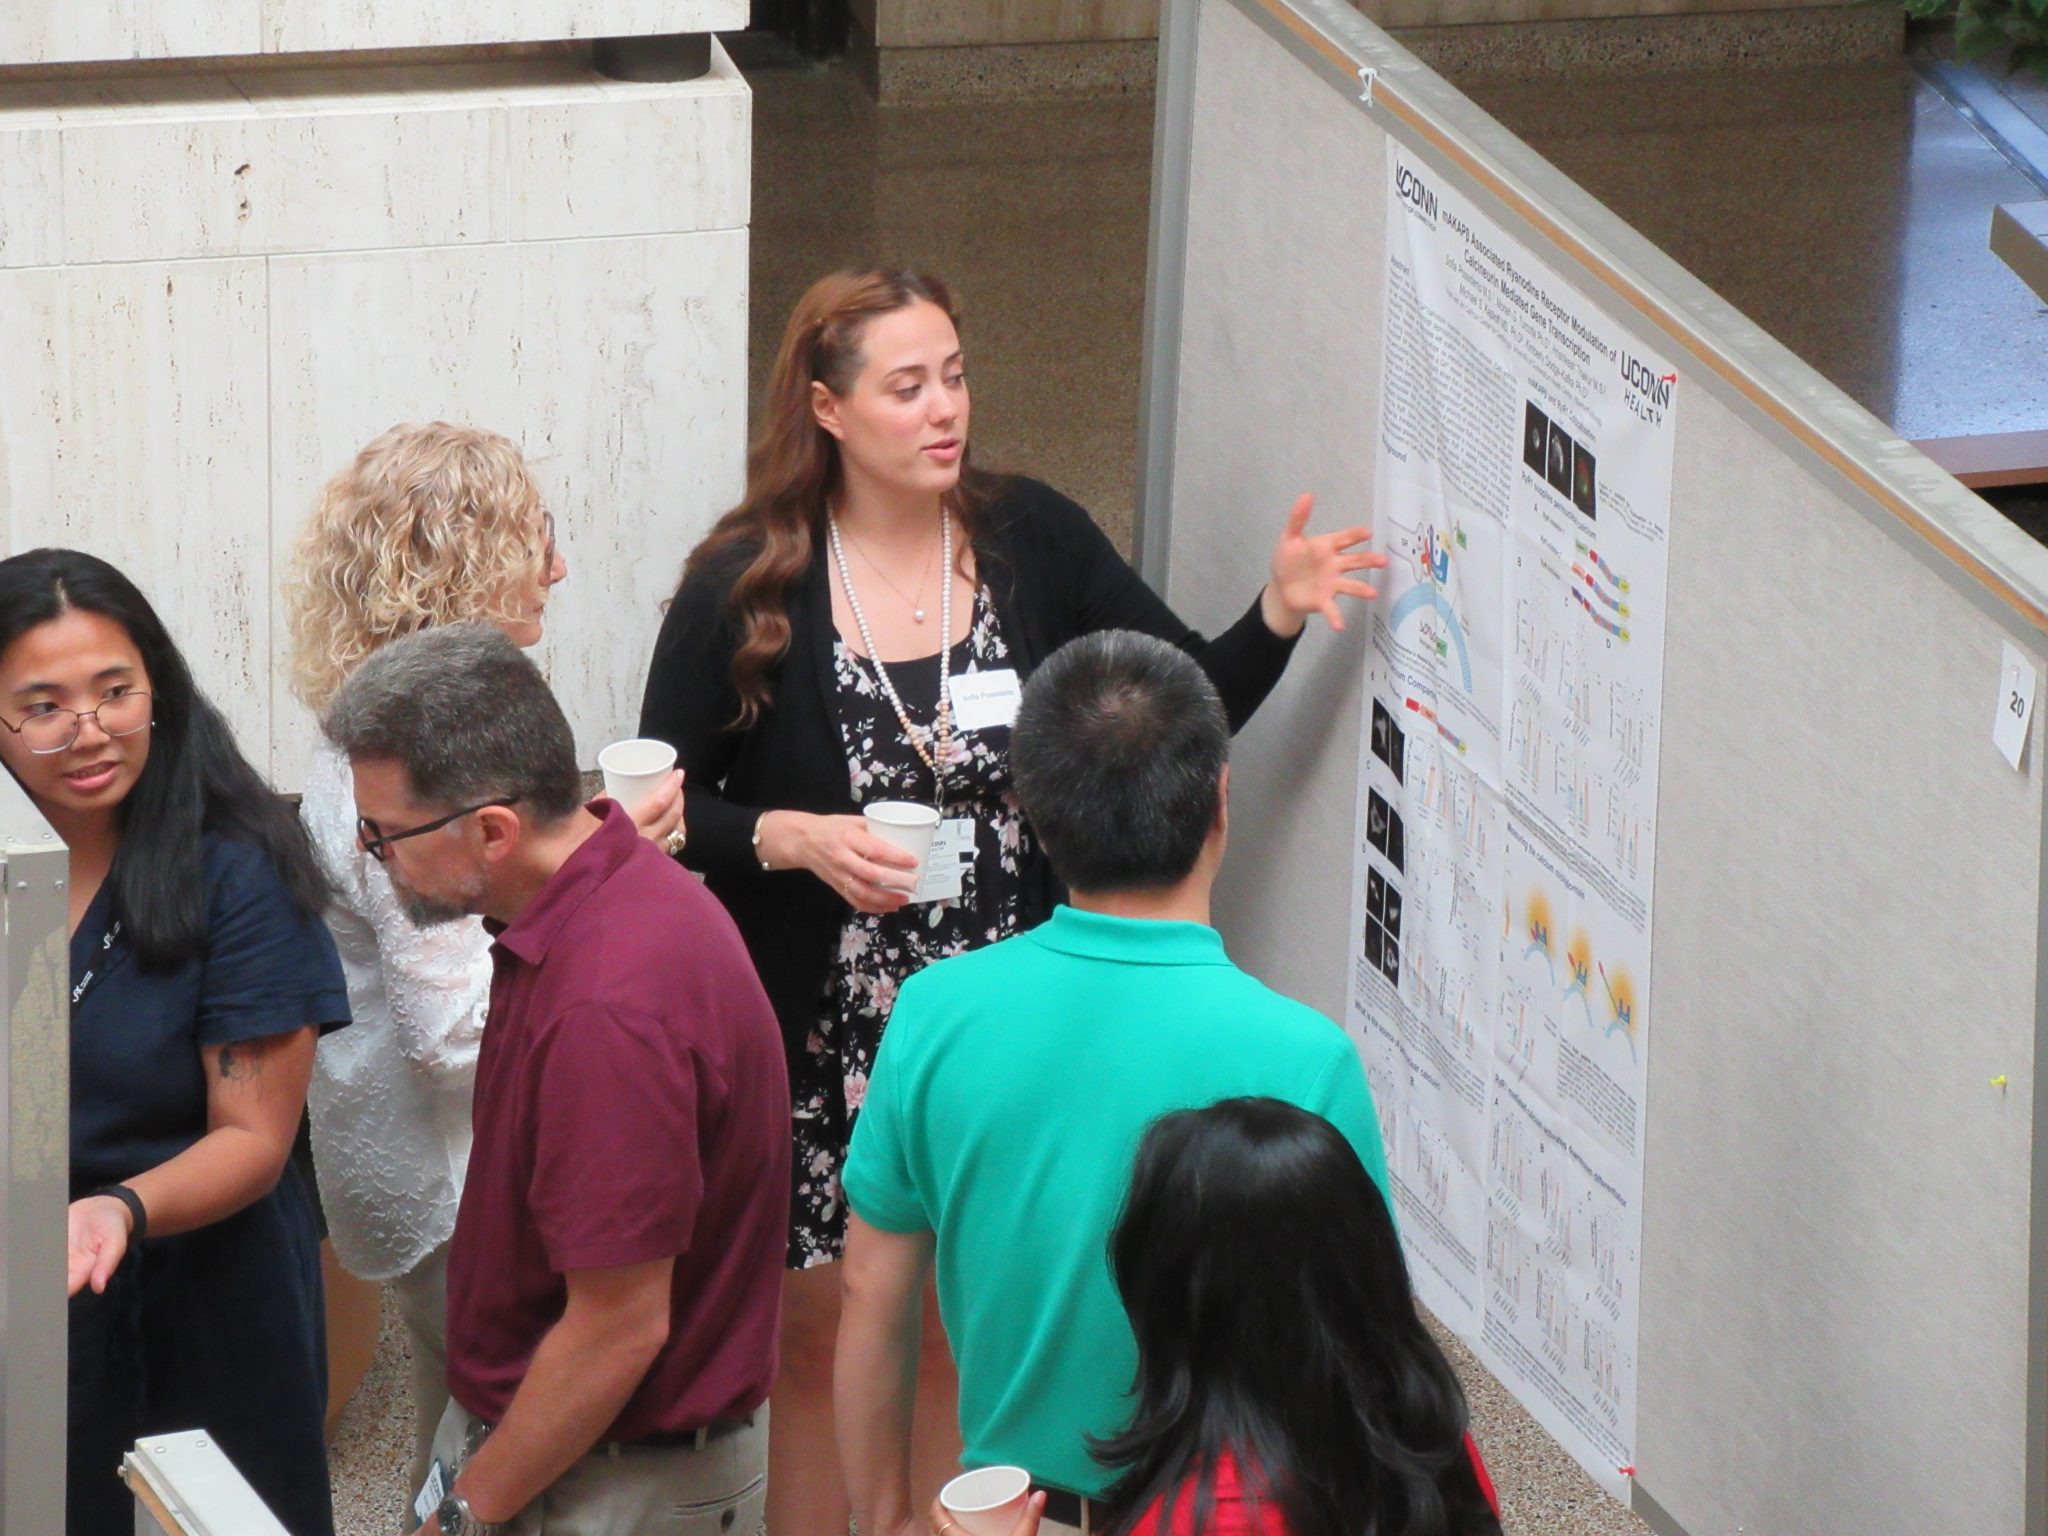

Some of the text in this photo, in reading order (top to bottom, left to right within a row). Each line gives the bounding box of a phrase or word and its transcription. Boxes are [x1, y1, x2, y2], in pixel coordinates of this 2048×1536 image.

[1464, 248, 1590, 367] Calcineurin Mediated Gene Transcription
[1470, 232, 1505, 270] Associated
[1506, 262, 1539, 302] Ryanodine
[1540, 290, 1570, 327] Receptor
[1571, 316, 1608, 356] Modulation
[1609, 346, 1616, 364] of
[1621, 351, 1669, 409] UCONN
[1624, 388, 1662, 429] HEALTH
[2009, 690, 2025, 718] 20
